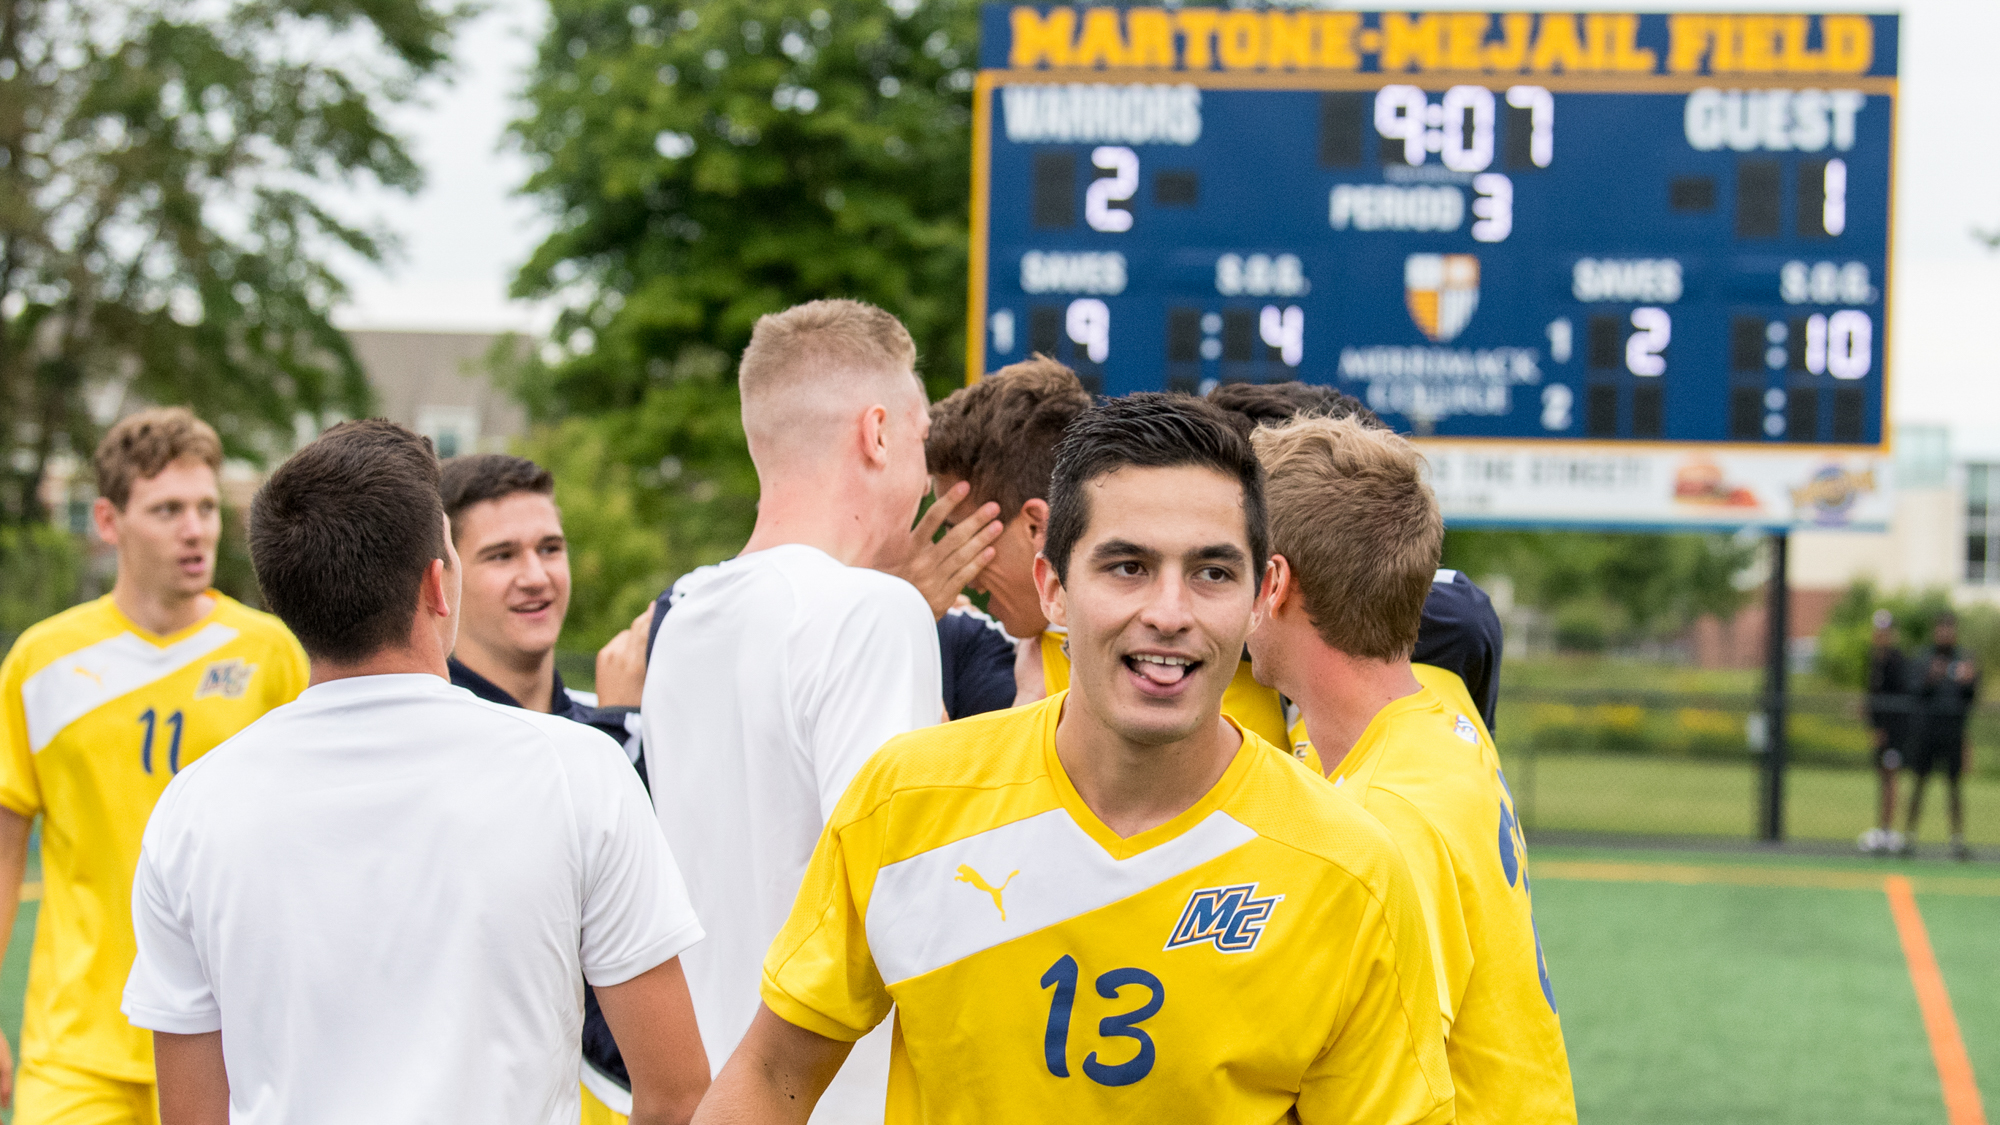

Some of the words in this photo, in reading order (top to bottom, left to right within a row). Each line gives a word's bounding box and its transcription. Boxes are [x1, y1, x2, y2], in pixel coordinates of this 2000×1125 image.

[1010, 8, 1656, 71] MARTONE-MEJAIL
[1667, 14, 1873, 74] FIELD
[1003, 84, 1201, 144] WARRIORS
[1374, 85, 1554, 172] 9:07
[1684, 87, 1864, 151] GUEST
[1085, 146, 1139, 232] 2
[1329, 184, 1465, 232] PERIOD
[1472, 173, 1513, 242] 3
[1822, 158, 1846, 236] 1
[1020, 250, 1128, 295] SAVES
[1573, 258, 1683, 302] SAVES
[1066, 299, 1110, 363] 9
[1546, 317, 1573, 364] 1
[1626, 307, 1671, 377] 2
[1339, 347, 1541, 384] MERRIMACK
[1541, 383, 1574, 431] 2
[138, 706, 183, 775] 11
[1163, 882, 1280, 954] MC
[1040, 953, 1165, 1087] 13
